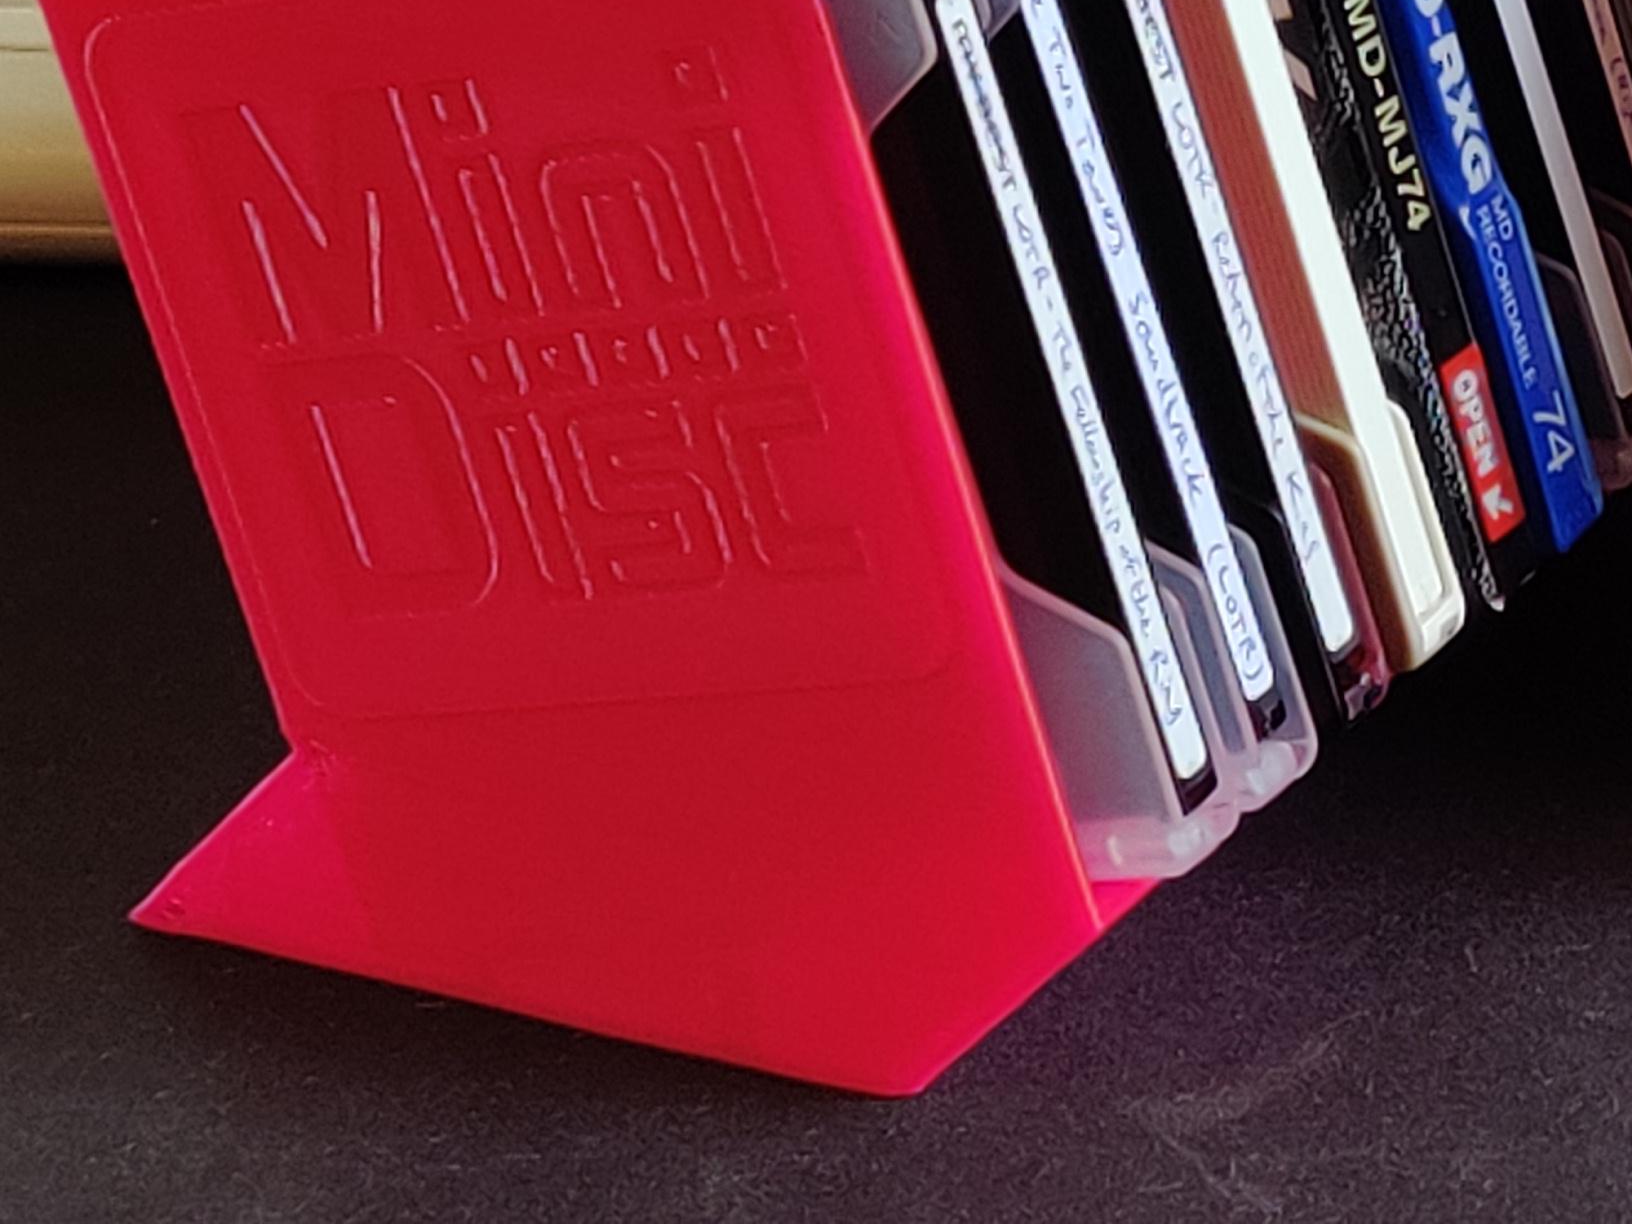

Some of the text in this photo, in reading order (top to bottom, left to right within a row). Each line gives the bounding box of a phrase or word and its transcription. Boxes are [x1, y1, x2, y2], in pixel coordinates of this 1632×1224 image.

[1046, 27, 1077, 110] Two
[182, 44, 787, 351] Mini
[1490, 196, 1514, 241] MD
[1475, 205, 1539, 384] RECORDABLE
[1451, 368, 1501, 477] OPEN
[1531, 389, 1577, 474] 74
